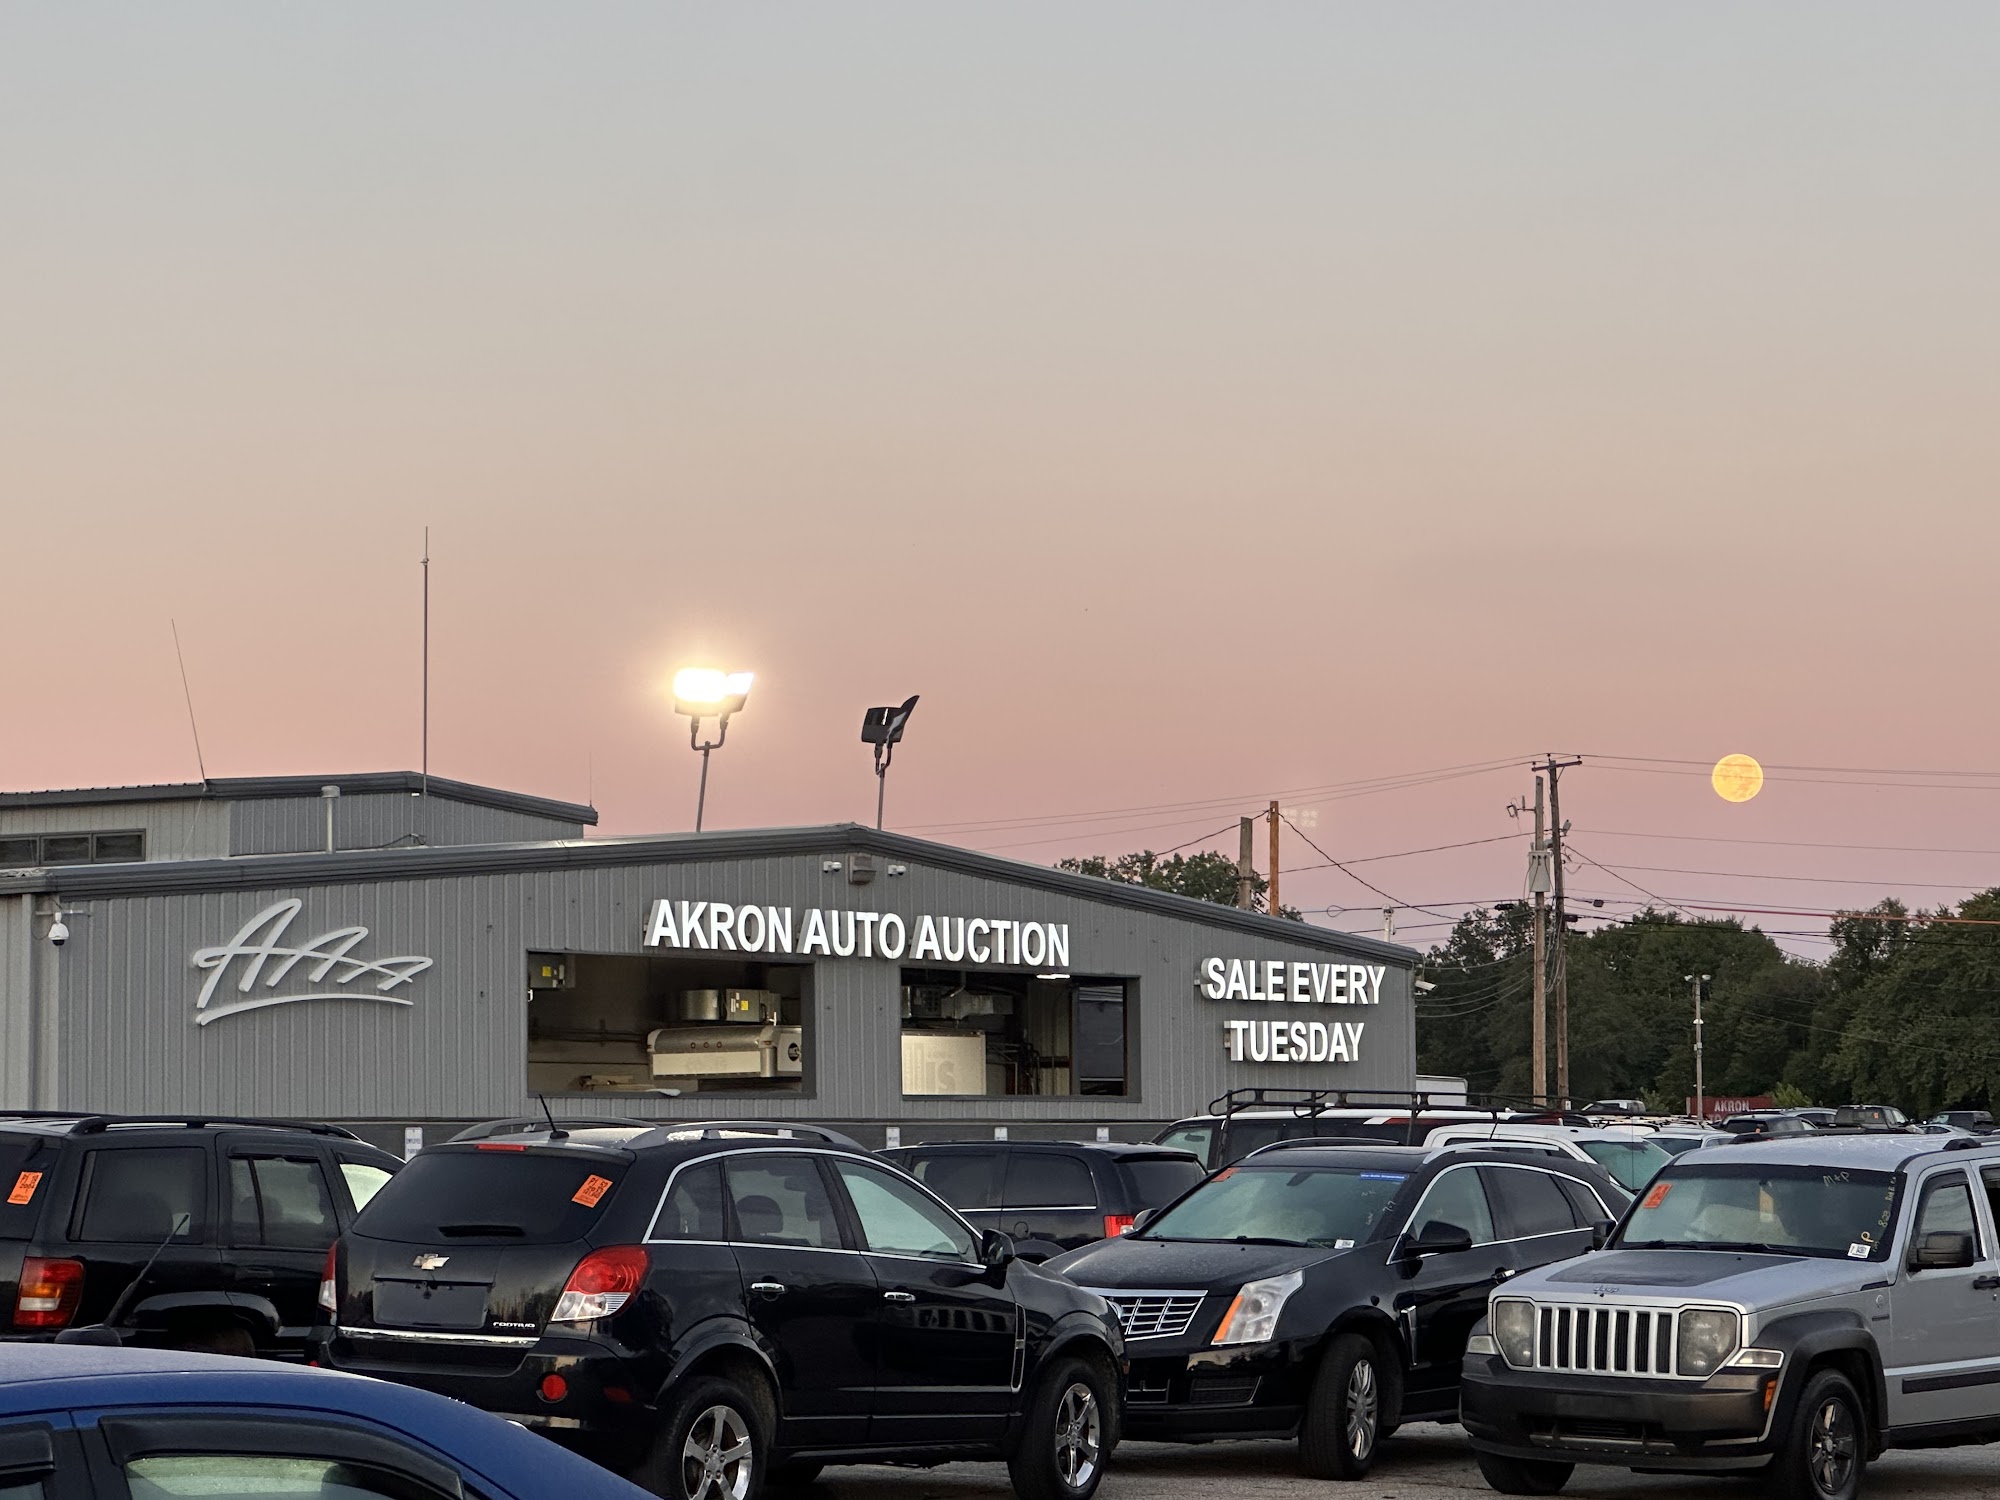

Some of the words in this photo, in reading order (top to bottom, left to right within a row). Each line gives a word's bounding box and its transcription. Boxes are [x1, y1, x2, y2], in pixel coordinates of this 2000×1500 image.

[645, 899, 792, 953] AKRON
[798, 908, 906, 960] AUTO
[910, 914, 1069, 967] AUCTION
[1201, 957, 1285, 1001] SALE
[1287, 962, 1386, 1004] EVERY
[1224, 1020, 1364, 1062] TUESDAY
[1714, 1100, 1750, 1112] AKRON
